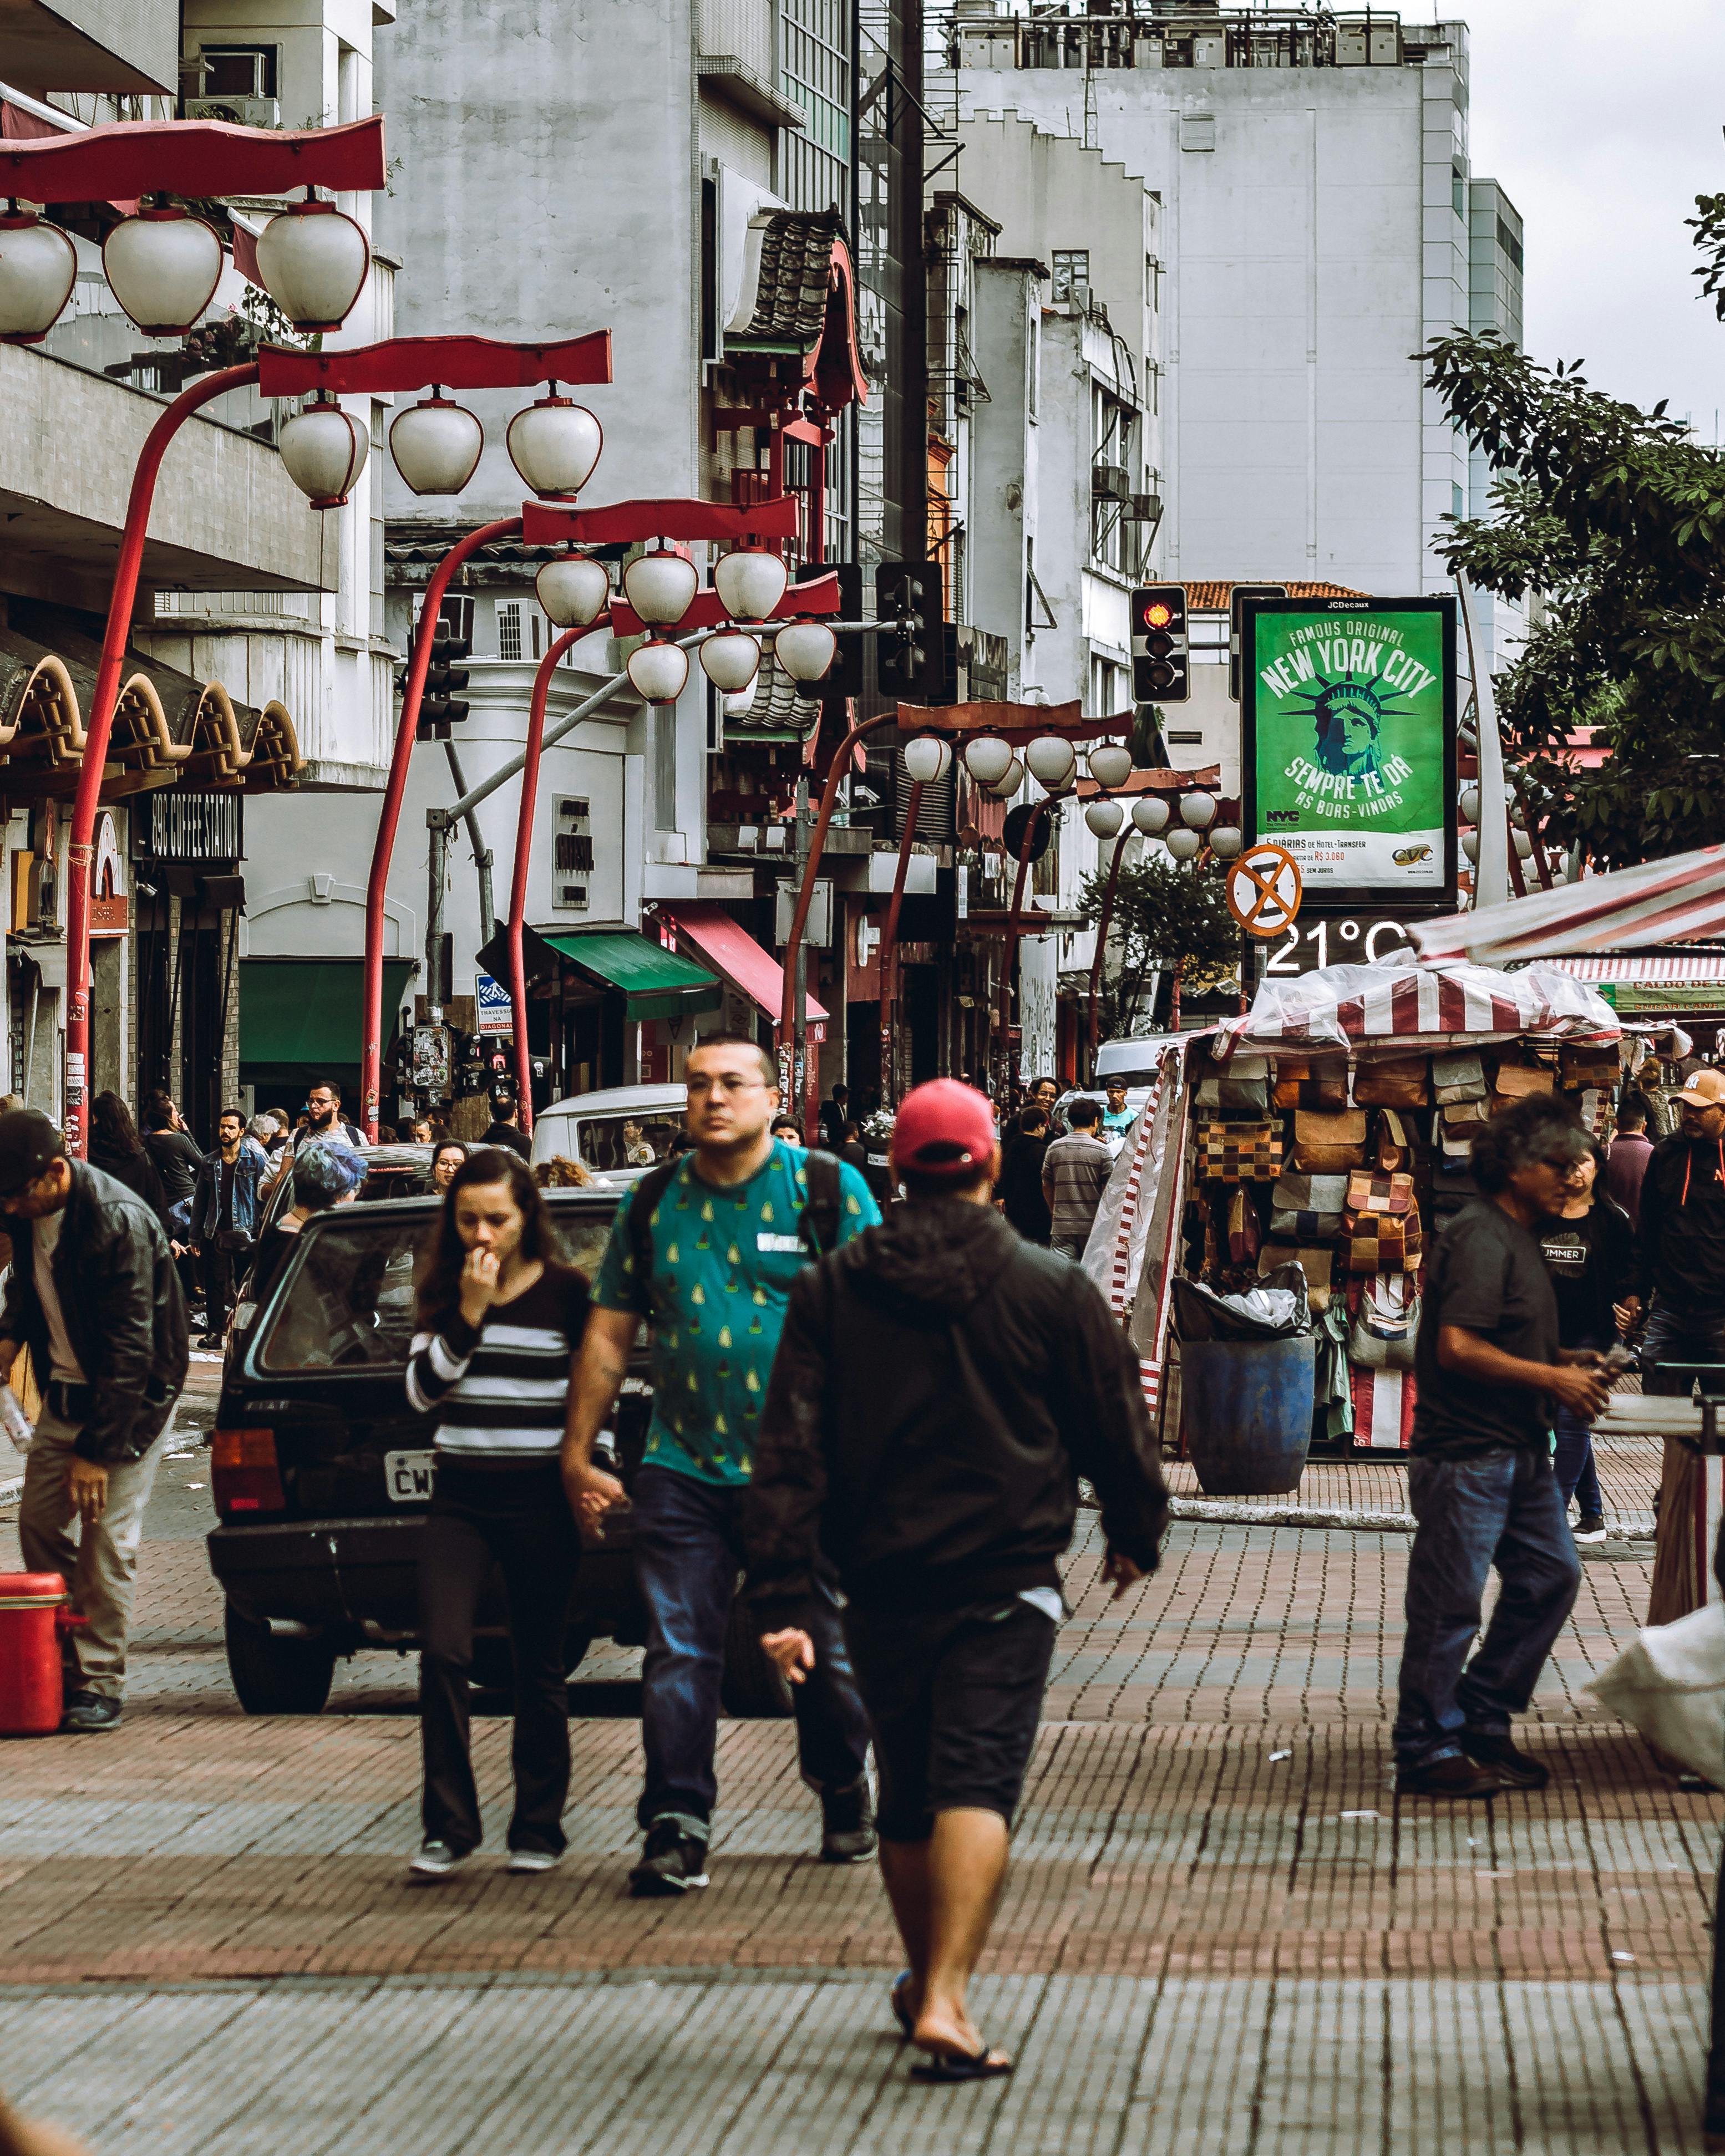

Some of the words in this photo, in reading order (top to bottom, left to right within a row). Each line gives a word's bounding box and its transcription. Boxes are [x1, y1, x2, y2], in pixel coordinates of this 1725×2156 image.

[1289, 621, 1341, 647] FAMOUS
[1346, 621, 1406, 647] ORIGINAL
[1259, 645, 1316, 699] NEW
[1316, 638, 1384, 677] YORK
[1382, 649, 1437, 699] CITY
[1284, 756, 1356, 800] SEMPRE
[1360, 770, 1385, 797] TE
[1382, 753, 1413, 786] DÁ
[1266, 810, 1300, 822] NYC
[1294, 791, 1314, 809] AS
[1316, 790, 1403, 819] BOAS-VINDAS
[171, 794, 202, 857] COFFEE
[205, 794, 238, 858] STATION
[1273, 836, 1306, 848] DIÁRIAS
[1392, 848, 1433, 862] CVC
[1315, 851, 1323, 862] R$
[1633, 980, 1687, 989] CALDO
[1691, 980, 1712, 988] DE
[394, 1468, 435, 1494] CW
